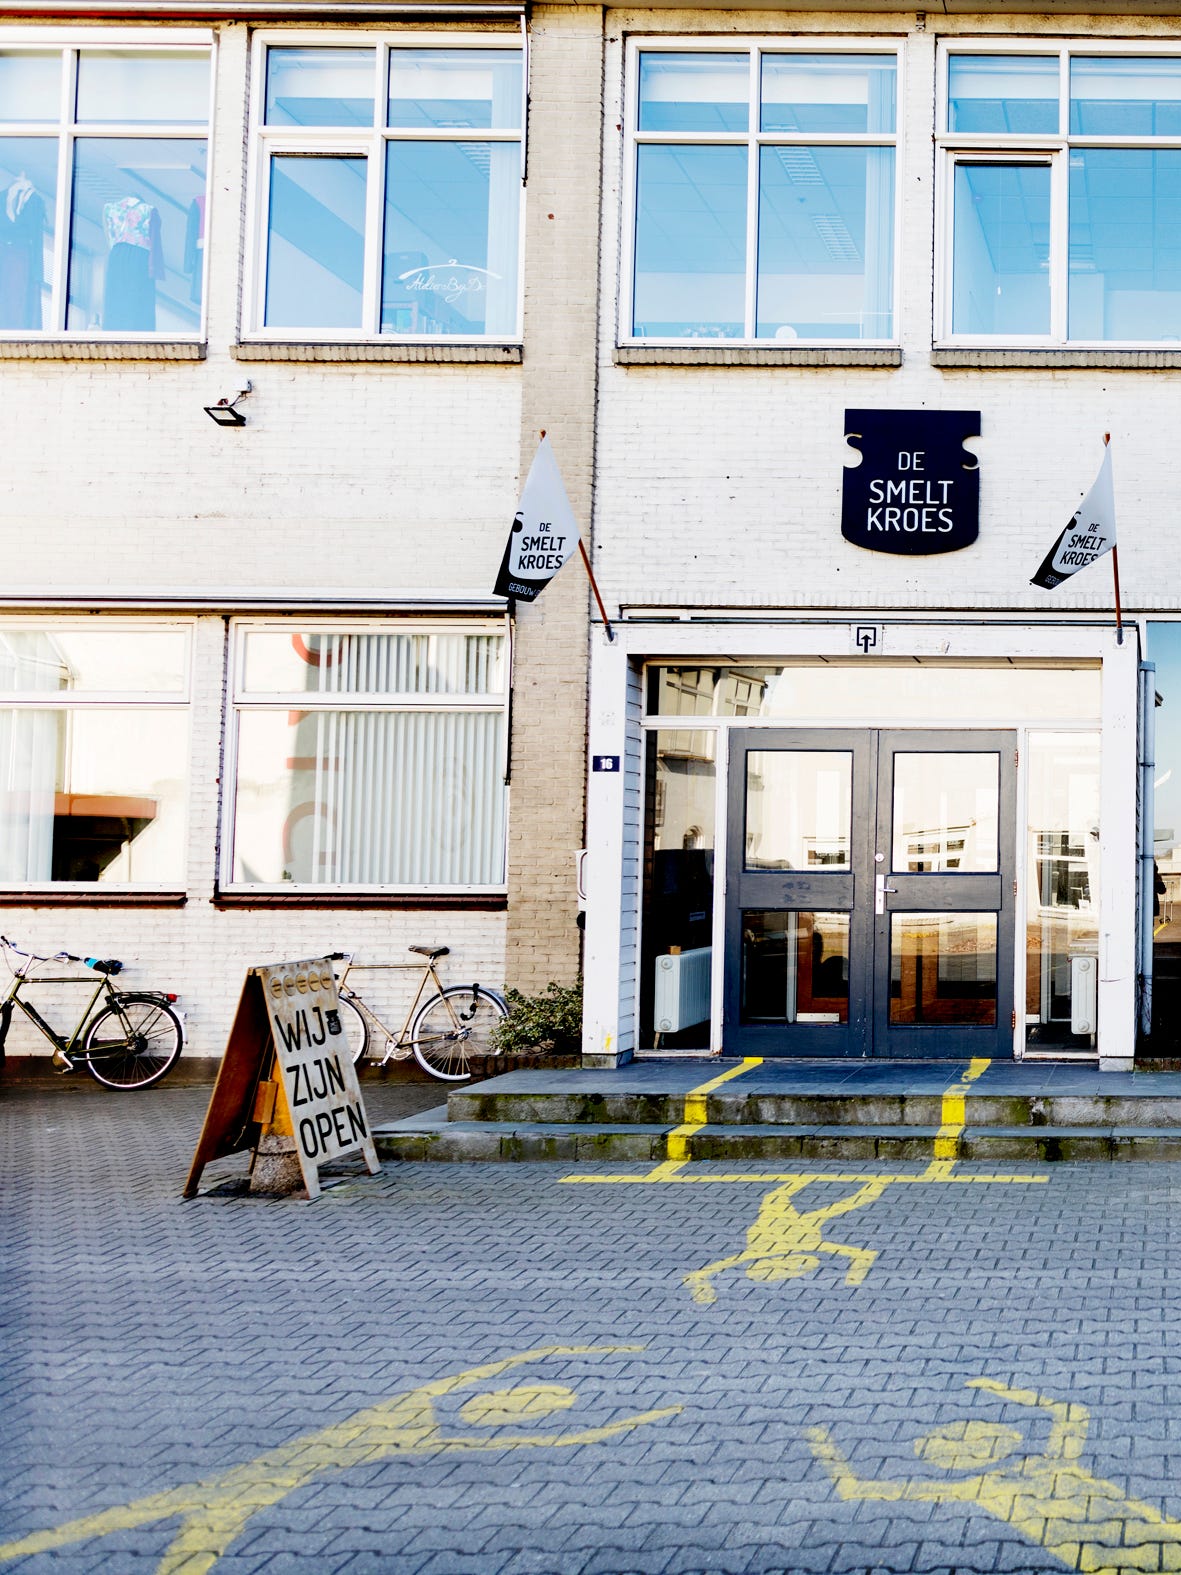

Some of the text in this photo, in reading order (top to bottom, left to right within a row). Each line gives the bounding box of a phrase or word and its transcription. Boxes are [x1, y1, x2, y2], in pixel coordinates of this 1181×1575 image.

[898, 451, 925, 470] DE
[869, 479, 954, 504] SMELT
[539, 522, 552, 532] DE
[867, 507, 953, 532] KROES
[1088, 523, 1100, 532] DE
[521, 536, 567, 551] SMELT
[1068, 534, 1107, 550] SMELT
[518, 555, 564, 569] KROES
[600, 758, 613, 770] 16
[274, 1006, 326, 1053] WIJ
[286, 1055, 346, 1107] ZIJN
[299, 1101, 367, 1158] OPEN
